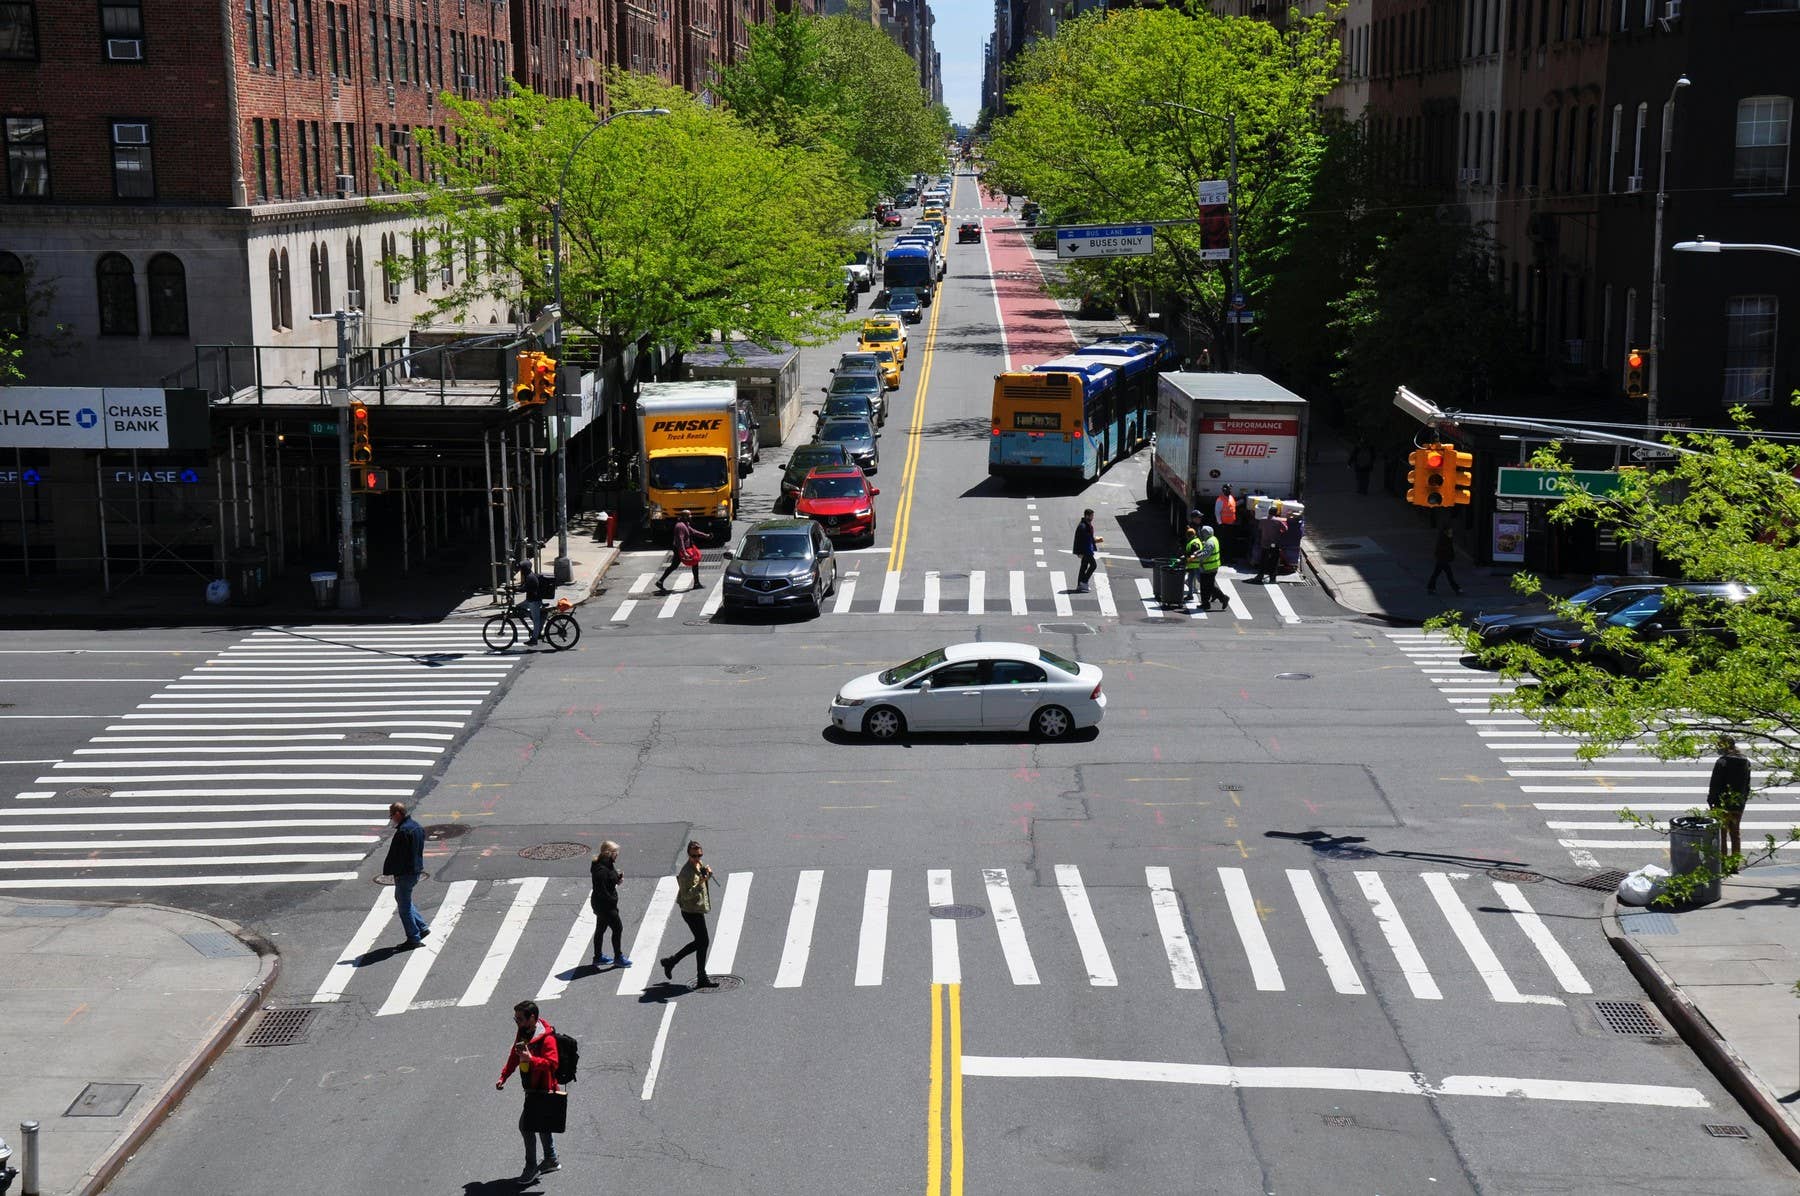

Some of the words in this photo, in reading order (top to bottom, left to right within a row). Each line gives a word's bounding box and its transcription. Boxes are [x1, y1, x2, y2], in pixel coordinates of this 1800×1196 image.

[1090, 239, 1118, 247] BUSES
[1121, 238, 1143, 246] ONLY
[109, 406, 163, 417] CHASE
[0, 410, 72, 426] HASE
[115, 421, 160, 432] BANK
[313, 423, 323, 433] 10
[652, 419, 723, 432] PENSKE
[1227, 421, 1282, 430] PERFORMANCE
[1226, 443, 1268, 457] ROMA
[1538, 476, 1558, 492] 10
